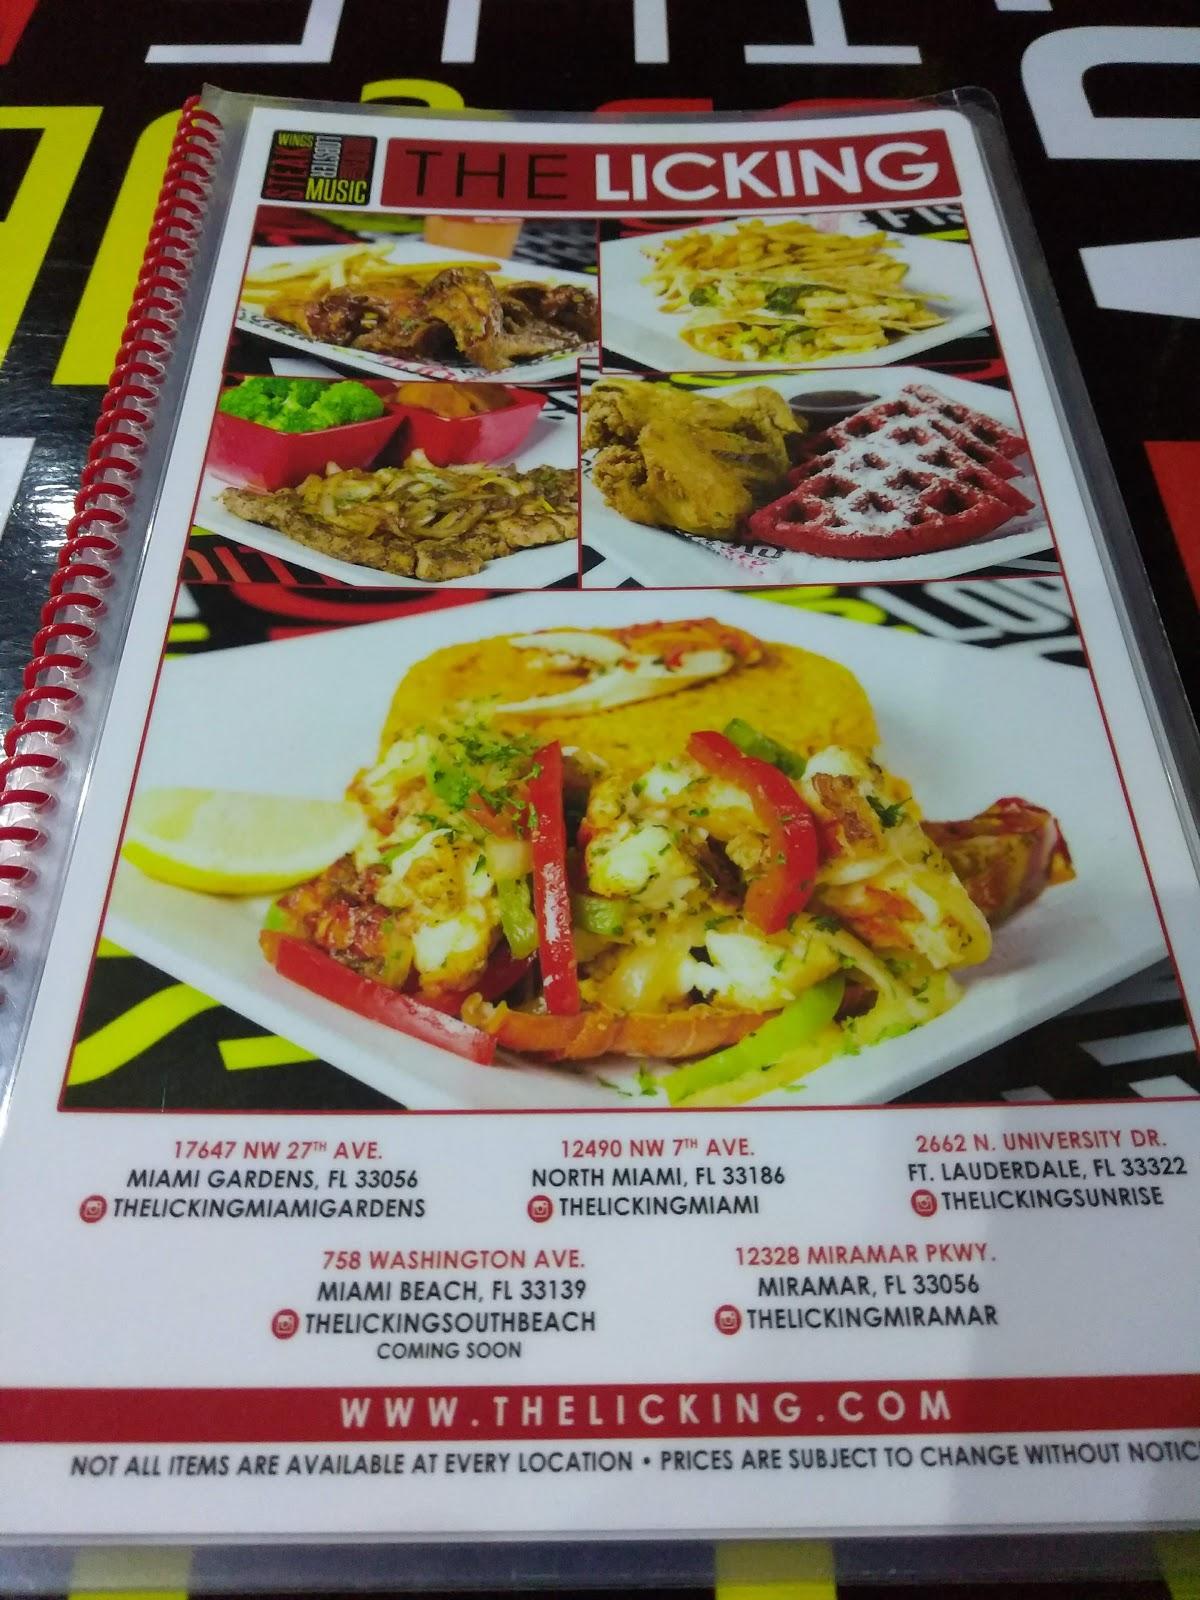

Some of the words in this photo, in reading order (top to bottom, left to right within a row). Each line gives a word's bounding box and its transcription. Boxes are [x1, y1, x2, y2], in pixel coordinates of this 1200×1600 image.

[278, 132, 315, 147] WINGS
[405, 149, 568, 200] THE
[594, 141, 939, 204] LICKING
[305, 177, 368, 204] MUSIC
[174, 1140, 237, 1160] 17647
[243, 1140, 280, 1160] NW
[333, 1140, 383, 1160] AVE.
[561, 1138, 623, 1159] 12490
[629, 1138, 665, 1158] NW
[705, 1137, 755, 1157] AVE.
[915, 1133, 967, 1153] 2662
[973, 1133, 996, 1152] N.
[1003, 1129, 1121, 1152] UNIVERSITY
[1131, 1128, 1167, 1149] DR.
[126, 1168, 201, 1189] MIAMI
[206, 1168, 320, 1191] GARDENS,
[327, 1169, 348, 1189] FL
[354, 1169, 418, 1189] 33056
[531, 1167, 605, 1188] NORTH
[611, 1166, 689, 1188] MIAMI,
[695, 1166, 716, 1186] FL
[722, 1165, 785, 1186] 33186
[907, 1162, 935, 1182] FT.
[941, 1159, 1087, 1182] LAUDERDALE,
[1093, 1158, 1117, 1178] FL
[1121, 1156, 1188, 1177] 33322
[112, 1197, 426, 1220] THELICKINGMIAMIGARDENS
[559, 1195, 760, 1217] THELICKINGMIAMI
[940, 1186, 1164, 1211] THELICKINGSUNRISE
[323, 1250, 361, 1271] 758
[368, 1249, 527, 1271] WASHINGTON
[533, 1248, 585, 1269] AVE.
[735, 1245, 800, 1267] 12328
[806, 1243, 919, 1265] MIRAMAR
[925, 1242, 997, 1263] PKWY.
[316, 1280, 392, 1302] MIAMI
[399, 1279, 484, 1304] BEACH,
[492, 1279, 514, 1301] FL
[519, 1278, 587, 1301] 33139
[757, 1274, 877, 1299] MIRAMAR,
[883, 1274, 907, 1296] FL
[912, 1272, 981, 1296] 33056
[304, 1310, 596, 1335] THELICKINGSOUTHBEACH
[746, 1305, 999, 1330] THELICKINGMIRAMAR
[376, 1342, 460, 1361] COMING
[465, 1341, 522, 1360] SOON
[340, 1390, 952, 1428] WWW.THELICKING.COM
[69, 1455, 119, 1478] NOT
[124, 1455, 161, 1478] ALL
[167, 1454, 230, 1477] ITEMS
[236, 1454, 279, 1476] ARE
[286, 1452, 405, 1476] AVAILABLE
[410, 1452, 438, 1475] AT
[444, 1452, 511, 1475] EVERY
[518, 1450, 633, 1474] LOCATION
[660, 1449, 734, 1471] PRICES
[740, 1448, 783, 1470] ARE
[788, 1446, 878, 1471] SUBJECT
[883, 1446, 913, 1469] TO
[920, 1444, 1020, 1468] CHANGE
[1024, 1441, 1120, 1465] WITHOUT
[1127, 1439, 1200, 1464] NOTIC
